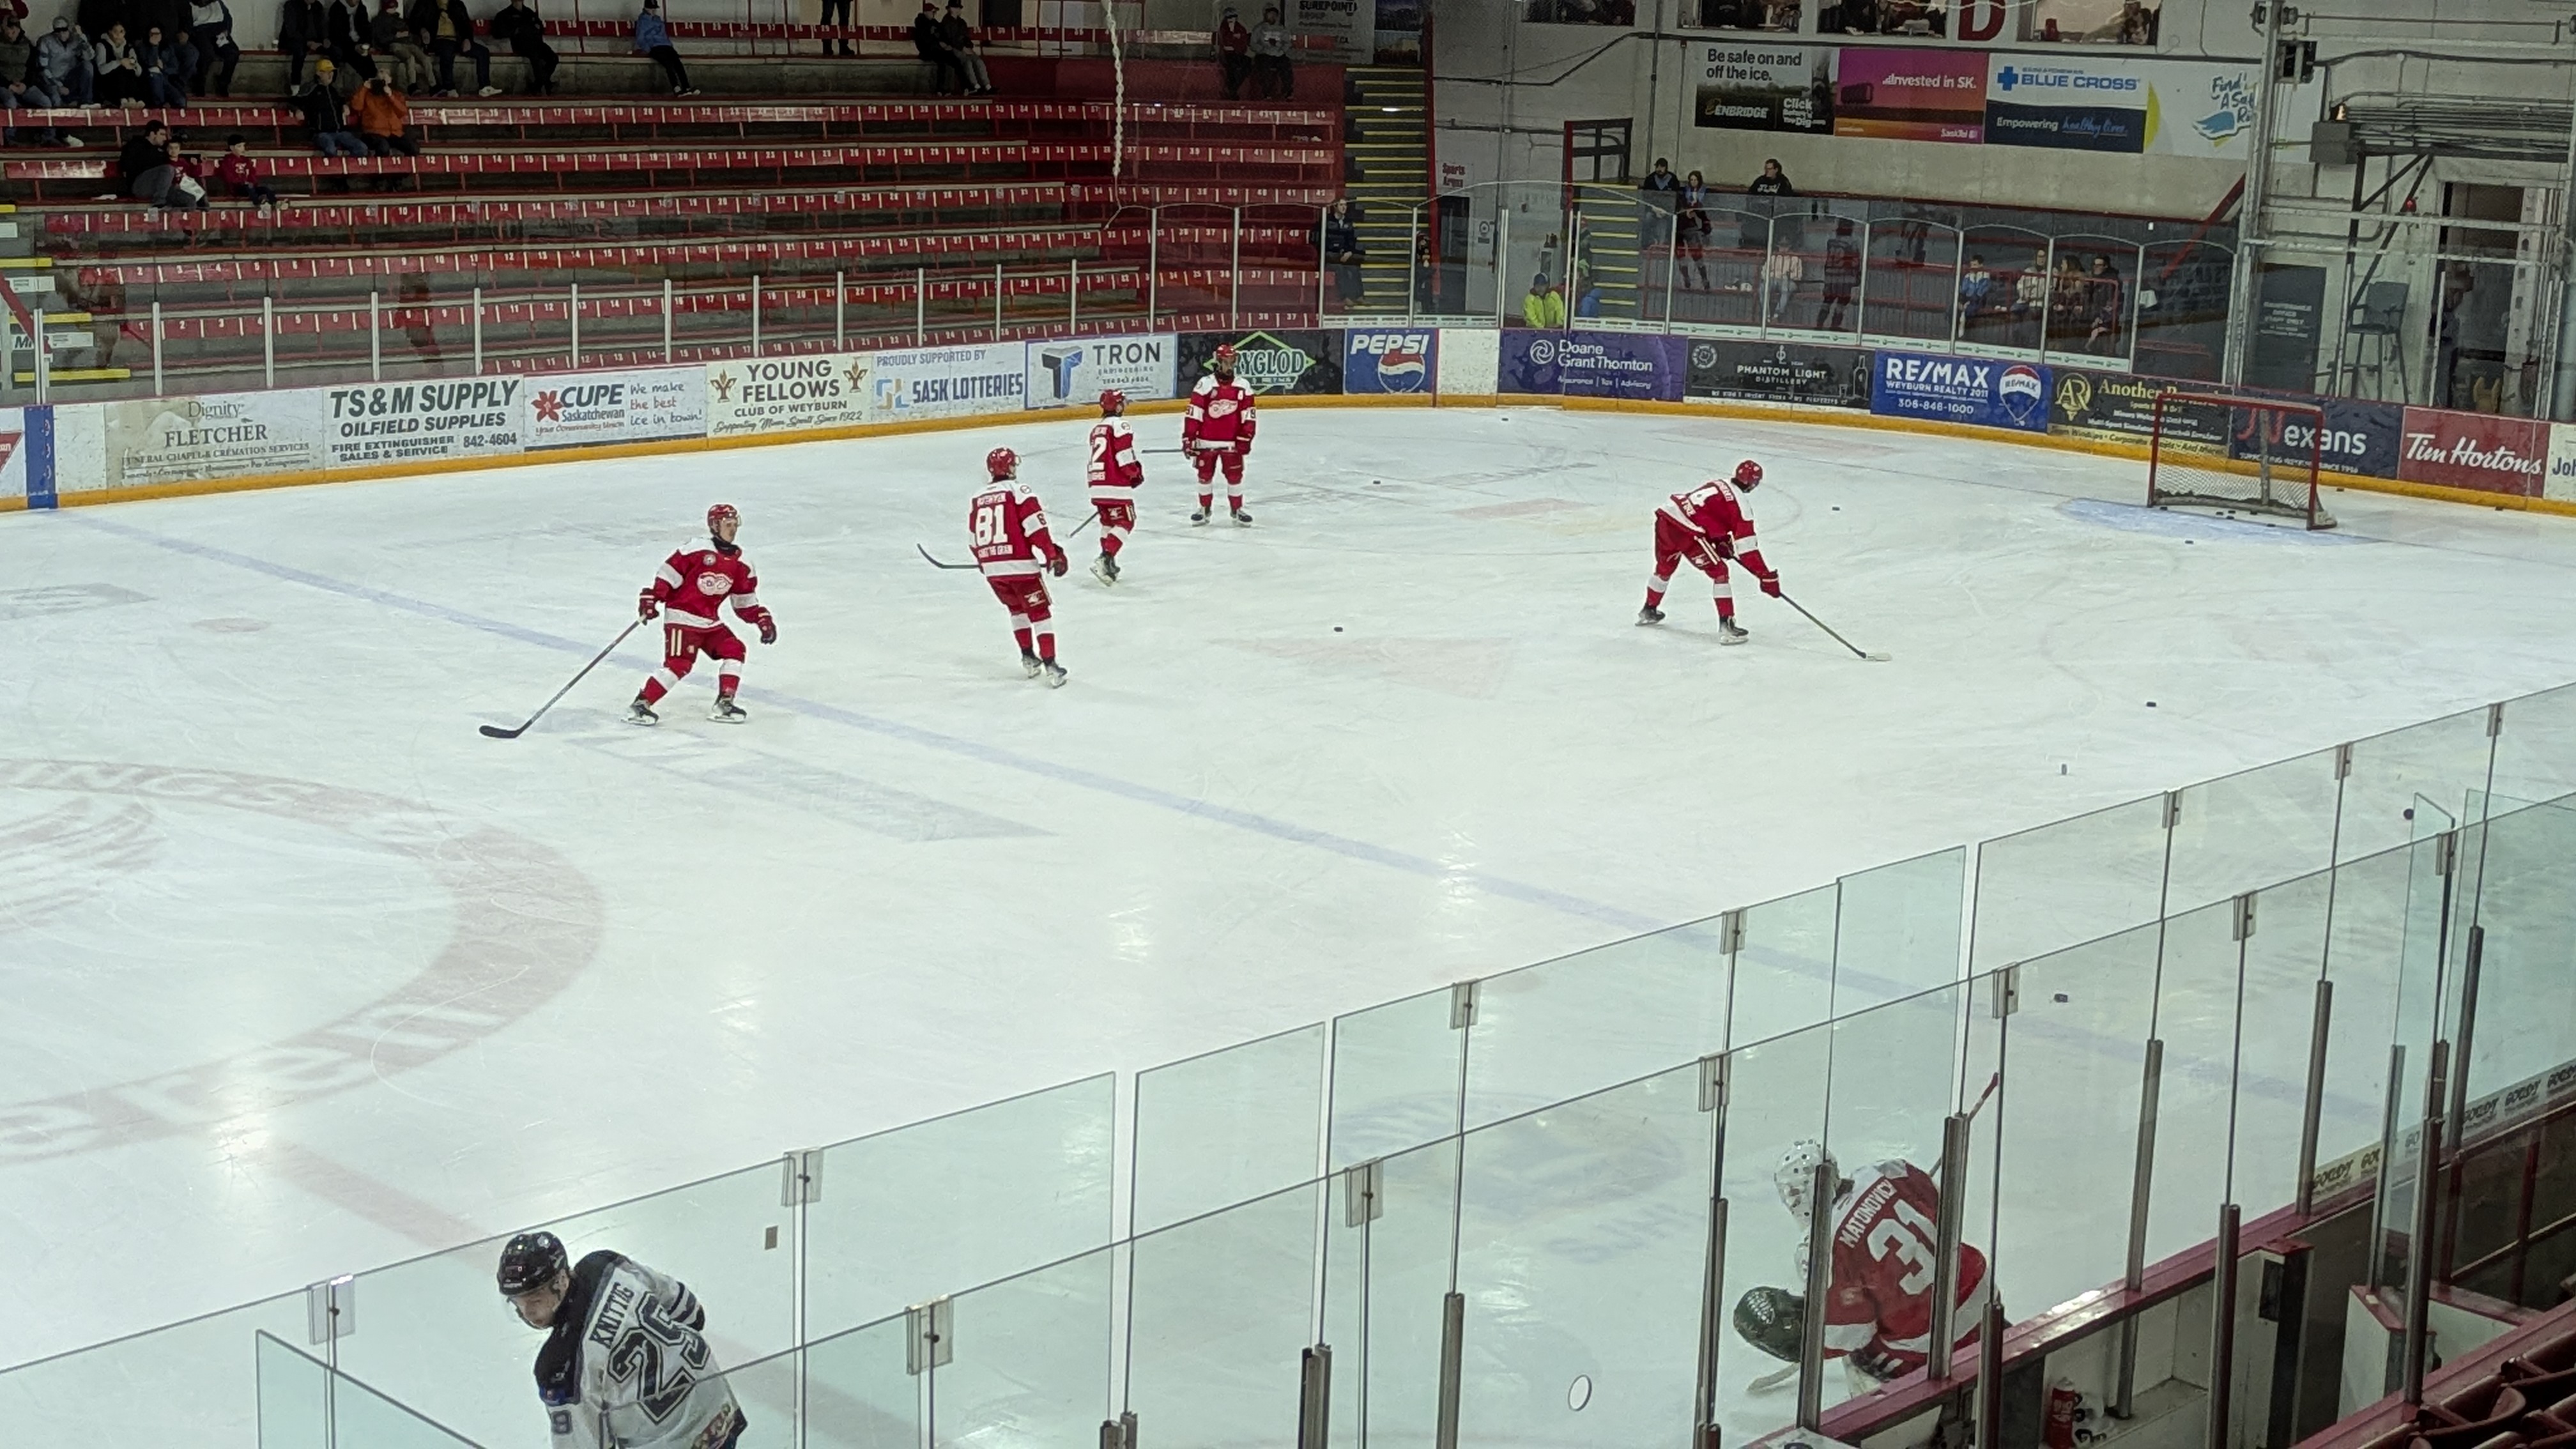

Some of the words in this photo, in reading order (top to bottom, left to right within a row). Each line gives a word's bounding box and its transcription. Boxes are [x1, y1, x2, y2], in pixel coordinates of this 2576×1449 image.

[1708, 49, 1725, 62] Be
[1727, 50, 1755, 63] safe
[1758, 55, 1774, 65] on
[1776, 52, 1802, 66] and
[1706, 66, 1724, 78] off
[1726, 66, 1747, 79] the
[1749, 68, 1772, 80] ice.
[1890, 74, 1940, 88] Invested
[1943, 75, 1954, 88] in
[1958, 77, 1976, 89] SK.
[2021, 73, 2069, 87] BLUE
[2073, 76, 2137, 90] CROSS
[1714, 106, 1769, 118] ENBRIDGE
[1783, 98, 1813, 109] Click
[1997, 116, 2059, 132] Empowering
[1351, 334, 1430, 355] PEPSI
[1559, 340, 1604, 355] Doane
[877, 354, 917, 367] PROUDLY
[919, 350, 972, 364] SUPPORTED
[974, 349, 986, 360] BY
[1092, 342, 1161, 366] TRON
[746, 360, 832, 382] YOUNG
[1558, 355, 1595, 369] Grant
[1595, 355, 1653, 372] Thornton
[1737, 365, 1789, 376] PHANTOM
[1795, 369, 1827, 379] LIGHT
[1885, 358, 1989, 388] RE/MAX
[631, 383, 647, 395] We
[652, 382, 685, 394] make
[742, 379, 840, 403] FELLOWS
[912, 378, 949, 404] SASK
[953, 372, 1023, 401] LOTTERIES
[1885, 380, 1932, 393] WEYBURN
[1934, 385, 1968, 396] REALTY
[2004, 379, 2038, 392] RE/MAX
[2097, 379, 2163, 400] Another
[330, 387, 415, 418] TS&M
[419, 379, 520, 413] SUPPLY
[560, 384, 625, 408] CUPE
[631, 399, 648, 410] the
[654, 396, 677, 408] best
[188, 401, 241, 419] Dignity
[562, 408, 625, 422] Saskatchewan
[631, 416, 648, 426] ice
[654, 415, 666, 425] in
[670, 409, 703, 423] town!
[734, 406, 765, 418] CLUB
[769, 404, 785, 415] OF
[788, 401, 847, 413] WEYBURN
[839, 410, 862, 422] 1922
[341, 418, 419, 438] OILFIELD
[424, 412, 507, 431] SUPPLIES
[165, 424, 268, 448] FLETCHER
[332, 442, 361, 453] FIRE
[365, 436, 454, 450] EXTINGUISHER
[463, 433, 517, 448] 842-4604
[213, 447, 266, 458] CREMATION
[269, 443, 310, 454] SERVICES
[340, 450, 379, 462] SALES
[383, 450, 392, 459] &
[396, 446, 448, 457] SERVICE
[2407, 433, 2446, 464] Tim
[2450, 436, 2542, 475] Hortons
[976, 504, 1008, 547] 81
